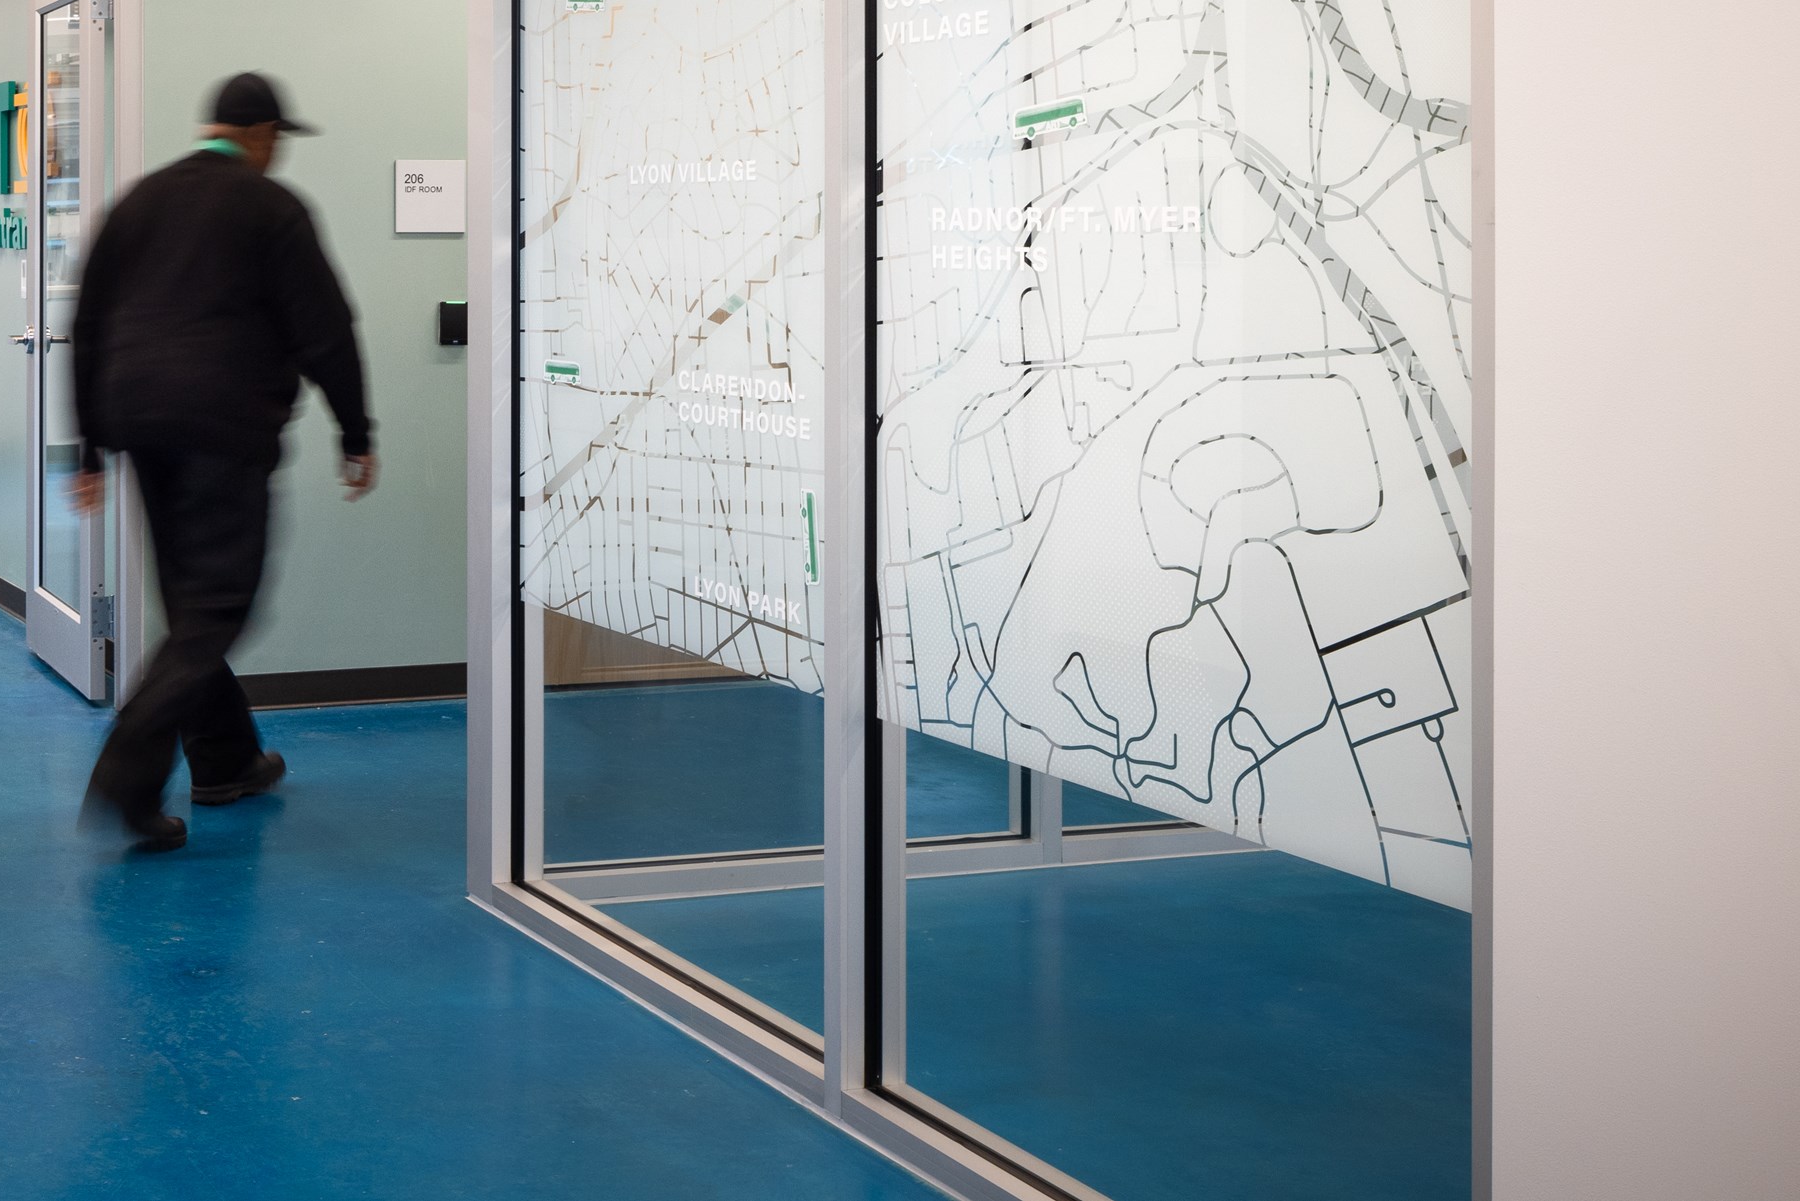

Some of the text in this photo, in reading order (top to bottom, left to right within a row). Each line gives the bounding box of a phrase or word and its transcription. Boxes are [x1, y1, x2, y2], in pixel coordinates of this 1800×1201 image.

[883, 10, 990, 45] VILLAGE
[404, 173, 424, 184] 206
[630, 160, 757, 185] LYON VILLAGE
[932, 206, 1201, 233] RADNOR/FT. MYER
[932, 246, 1049, 272] HEIGHTS
[678, 370, 806, 403] CLARENDON-
[678, 401, 811, 440] COURTHOUSE
[694, 576, 801, 624] LYON PARK
